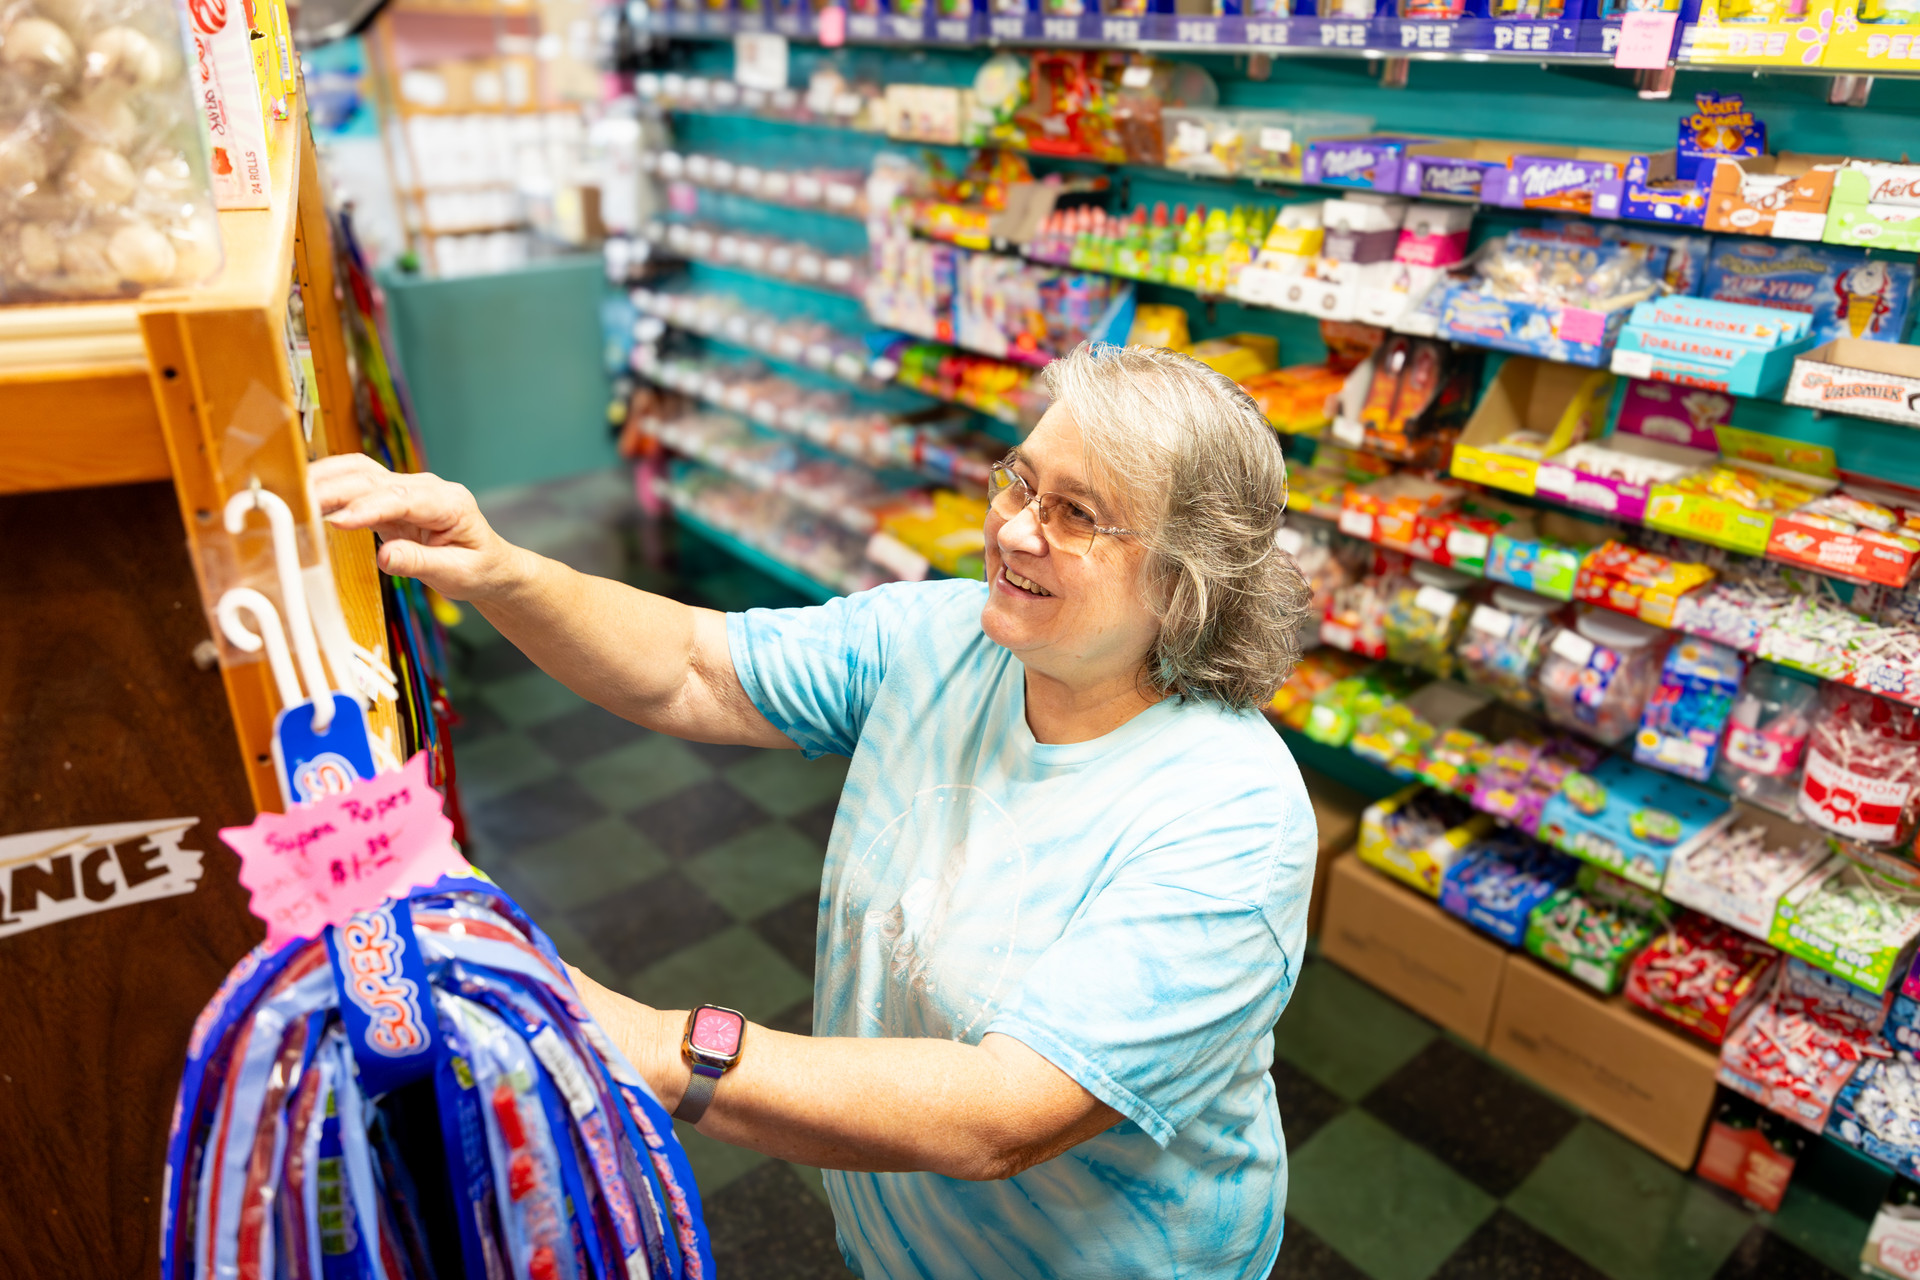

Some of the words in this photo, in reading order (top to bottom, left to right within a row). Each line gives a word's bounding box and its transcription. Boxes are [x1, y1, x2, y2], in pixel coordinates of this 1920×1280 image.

[1246, 23, 1288, 44] PEZ
[1320, 24, 1366, 46] PEZ
[1401, 25, 1450, 47] PEZ
[1494, 26, 1551, 50] PEZ
[1727, 32, 1788, 56] PEZ
[245, 151, 260, 181] ROLLS
[1521, 162, 1587, 195] Milka
[252, 182, 263, 195] 24
[1654, 308, 1748, 335] TOBLERONE
[1641, 332, 1735, 360] TOBLERONE
[0, 835, 171, 926] NCE
[341, 910, 424, 1055] SUPER
